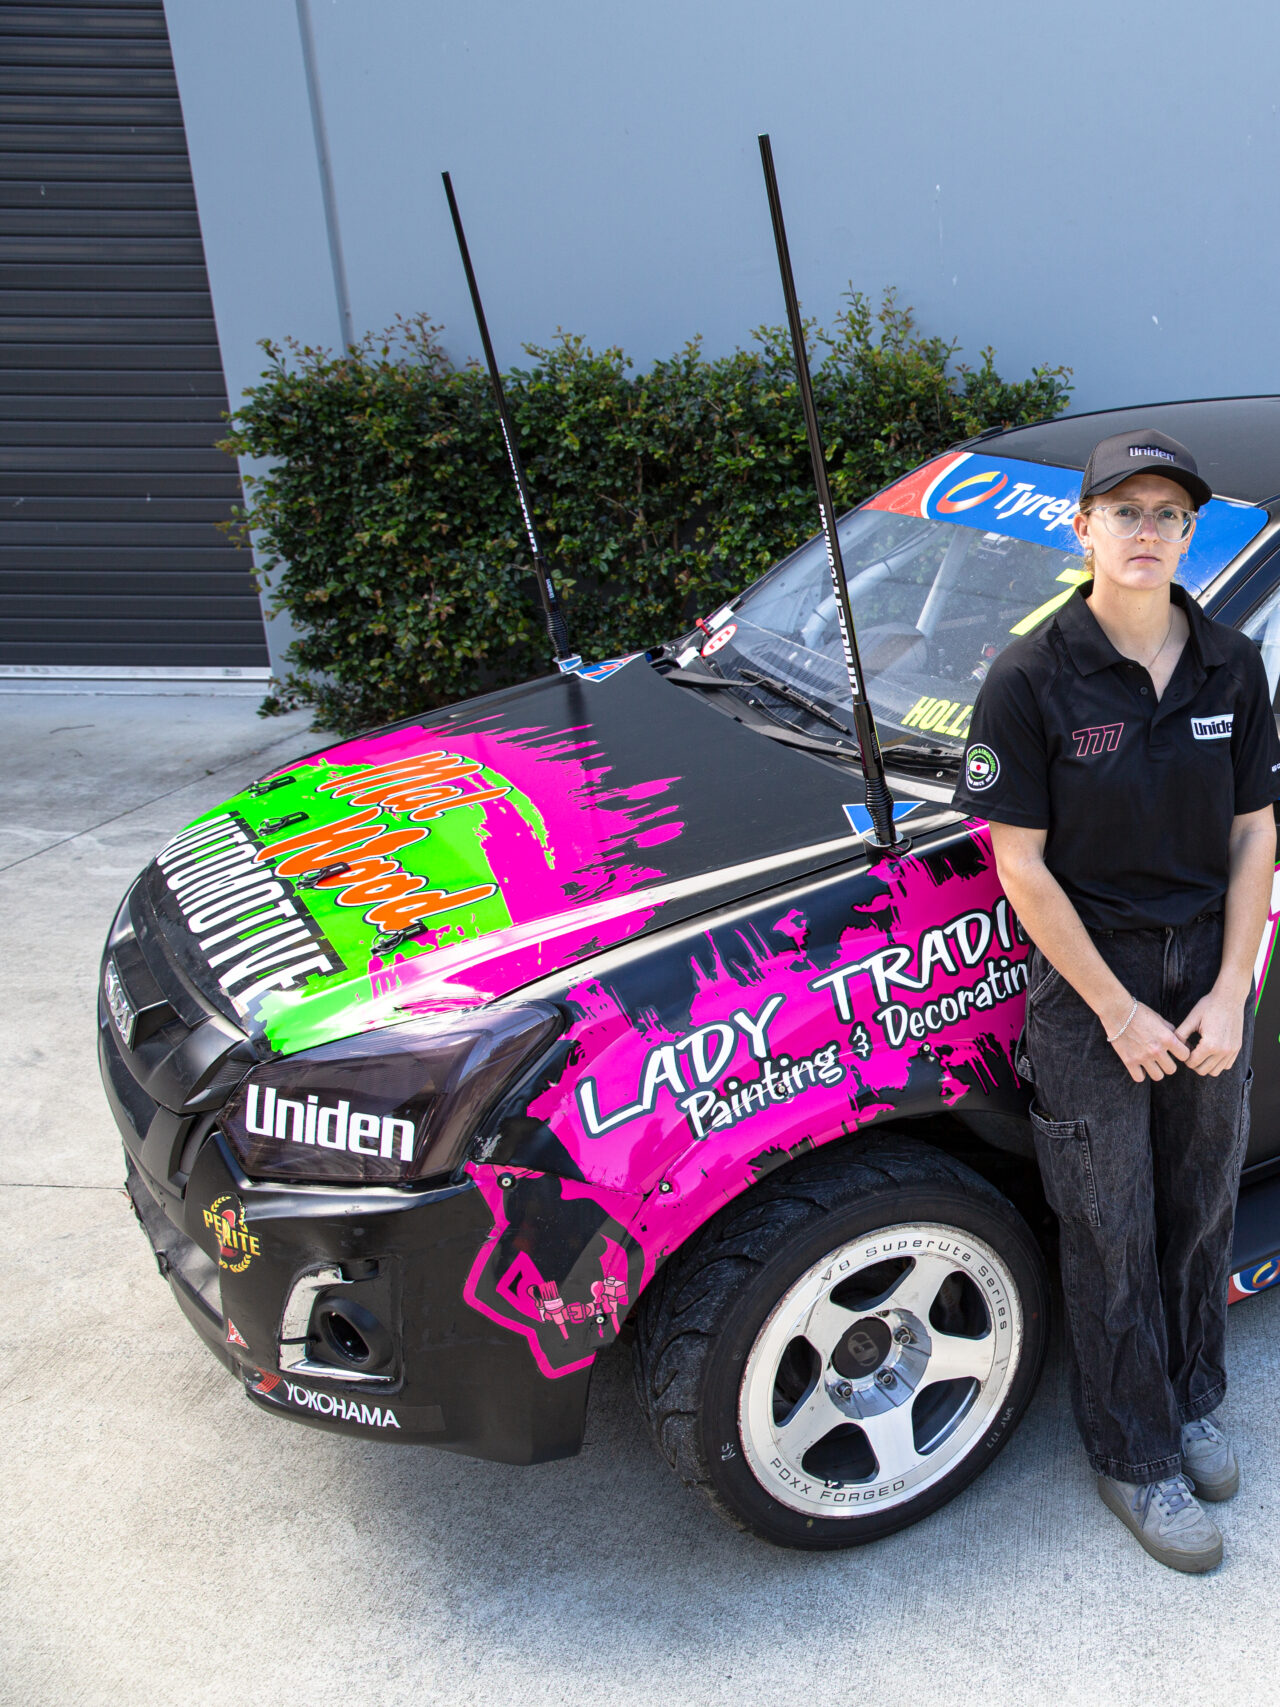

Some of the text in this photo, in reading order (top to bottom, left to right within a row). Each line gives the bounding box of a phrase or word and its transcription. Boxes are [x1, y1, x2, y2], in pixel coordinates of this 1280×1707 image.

[1129, 447, 1175, 462] Uniden
[1072, 722, 1124, 757] 777
[317, 750, 514, 822] Mal
[253, 806, 498, 931] Wood
[156, 813, 334, 1018] AUTOMOTIVE
[576, 898, 1024, 1137] LADY TRADI
[246, 1084, 415, 1162] Uniden
[682, 1045, 842, 1140] Painting
[202, 1209, 261, 1257] PERITE
[821, 1259, 850, 1281] V8
[978, 1265, 1006, 1330] Series
[282, 1379, 401, 1428] YOKOHAMA
[820, 1479, 905, 1502] FORGED
